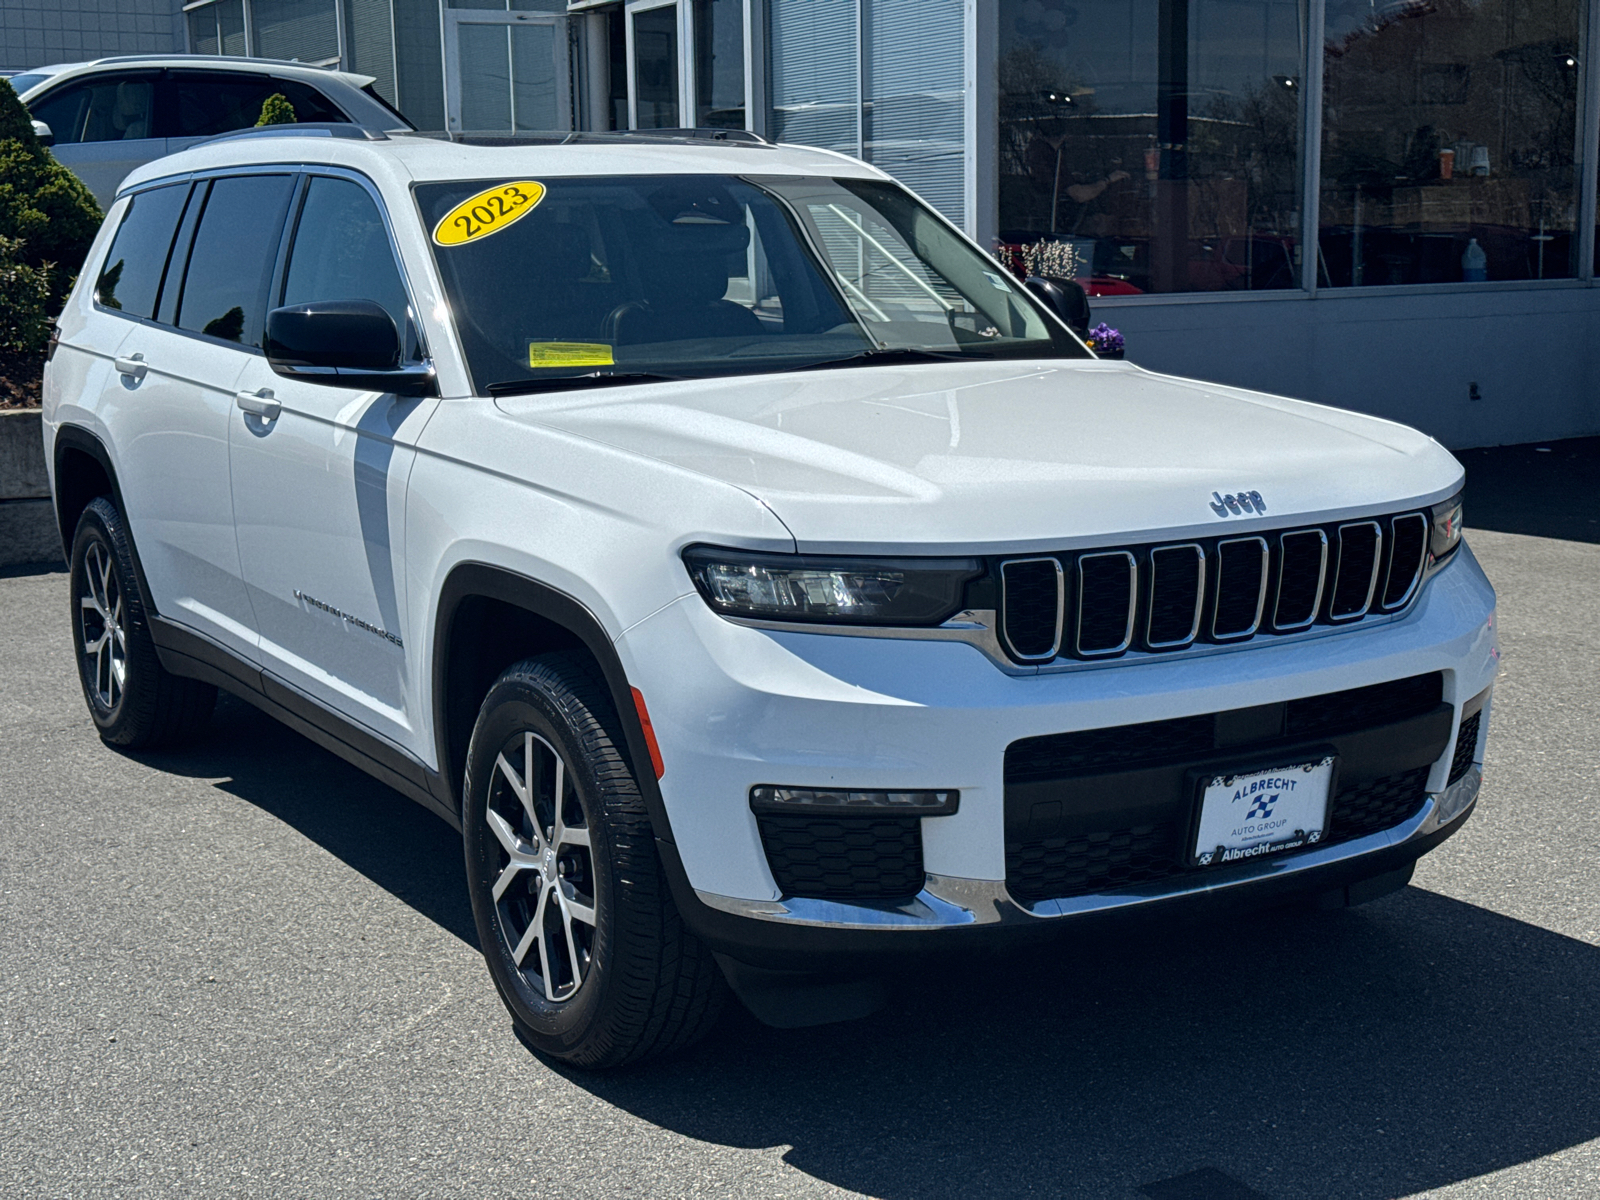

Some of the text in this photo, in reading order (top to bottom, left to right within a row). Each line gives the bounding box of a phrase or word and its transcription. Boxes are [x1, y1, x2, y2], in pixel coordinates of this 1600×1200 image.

[454, 187, 529, 237] 2023
[1209, 490, 1264, 513] Jeep
[1231, 778, 1297, 803] ALBRECHT
[1231, 819, 1287, 837] AUTO GROUP
[1221, 840, 1303, 862] Albrecht AUTO GROUP
